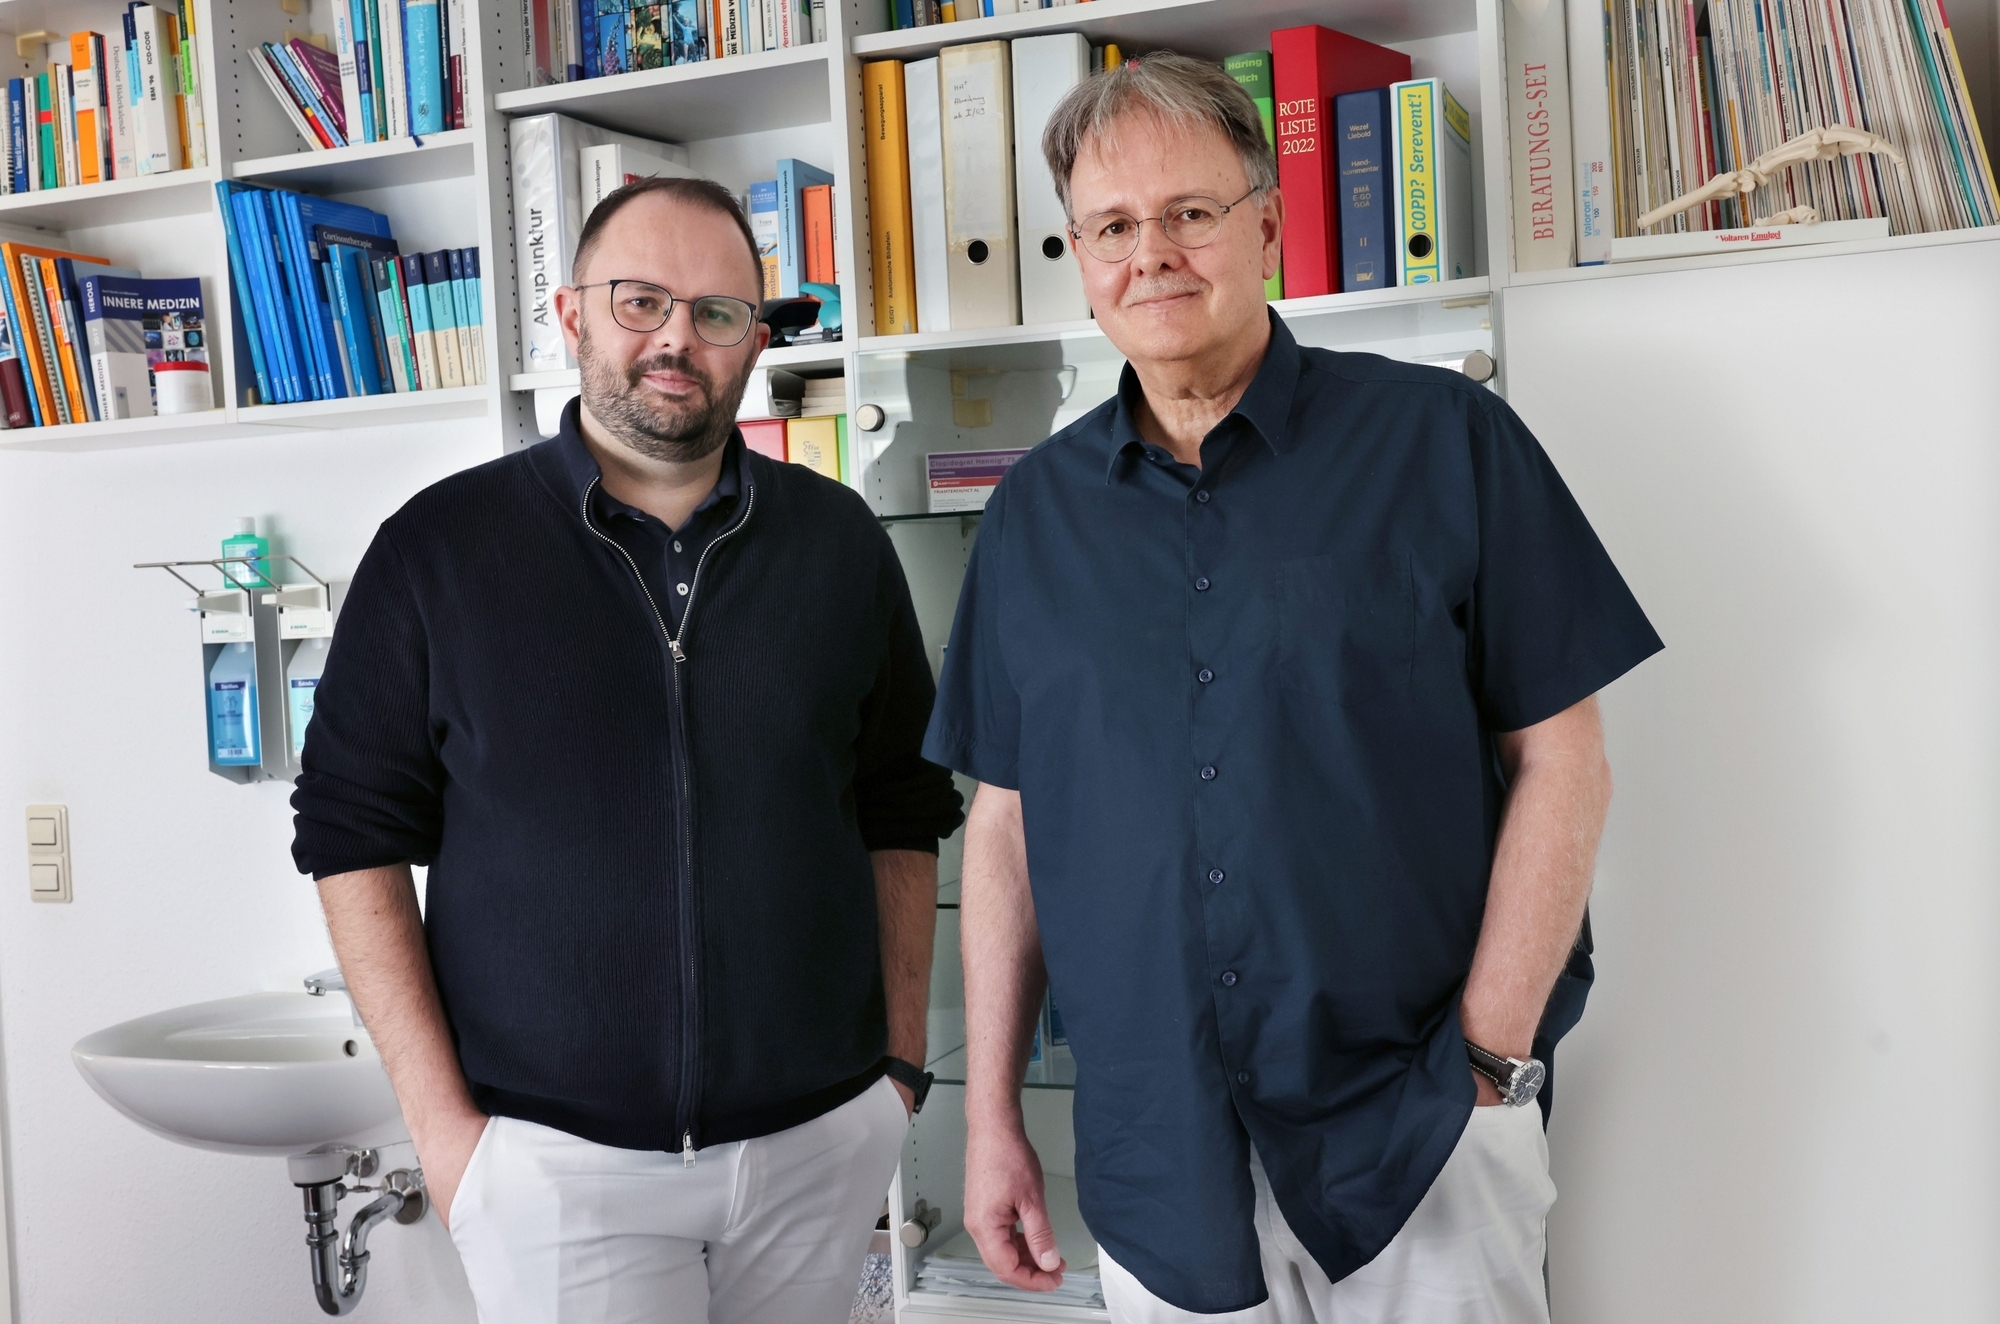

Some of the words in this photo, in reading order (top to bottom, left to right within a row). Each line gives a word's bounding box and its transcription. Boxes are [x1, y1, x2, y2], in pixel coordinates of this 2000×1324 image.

[339, 17, 348, 54] Impfcodex
[144, 31, 152, 65] ICD-CODE
[113, 45, 121, 82] Deutscher
[1228, 58, 1263, 71] Häring
[116, 84, 125, 136] Bäderkalender
[1279, 98, 1316, 117] ROTE
[1280, 118, 1317, 136] LISTE
[1348, 130, 1372, 140] Liebold
[1350, 123, 1370, 132] Wezel
[1407, 93, 1425, 173] Serevent!
[1282, 137, 1316, 155] 2022
[1524, 63, 1554, 240] BERATUNGS-SET
[1582, 189, 1590, 198] N
[1410, 179, 1427, 231] COPD?
[323, 230, 373, 249] Cortisontherapie
[1720, 232, 1749, 242] Voltaren
[1750, 230, 1781, 241] Emulgel
[528, 208, 549, 326] Akupunktur
[86, 280, 96, 313] HEROLD
[103, 295, 144, 310] INNERE
[146, 297, 200, 310] MEDIZIN
[91, 326, 100, 347] 2017
[96, 358, 106, 391] MEDIZIN
[930, 459, 974, 468] Clopidogrel
